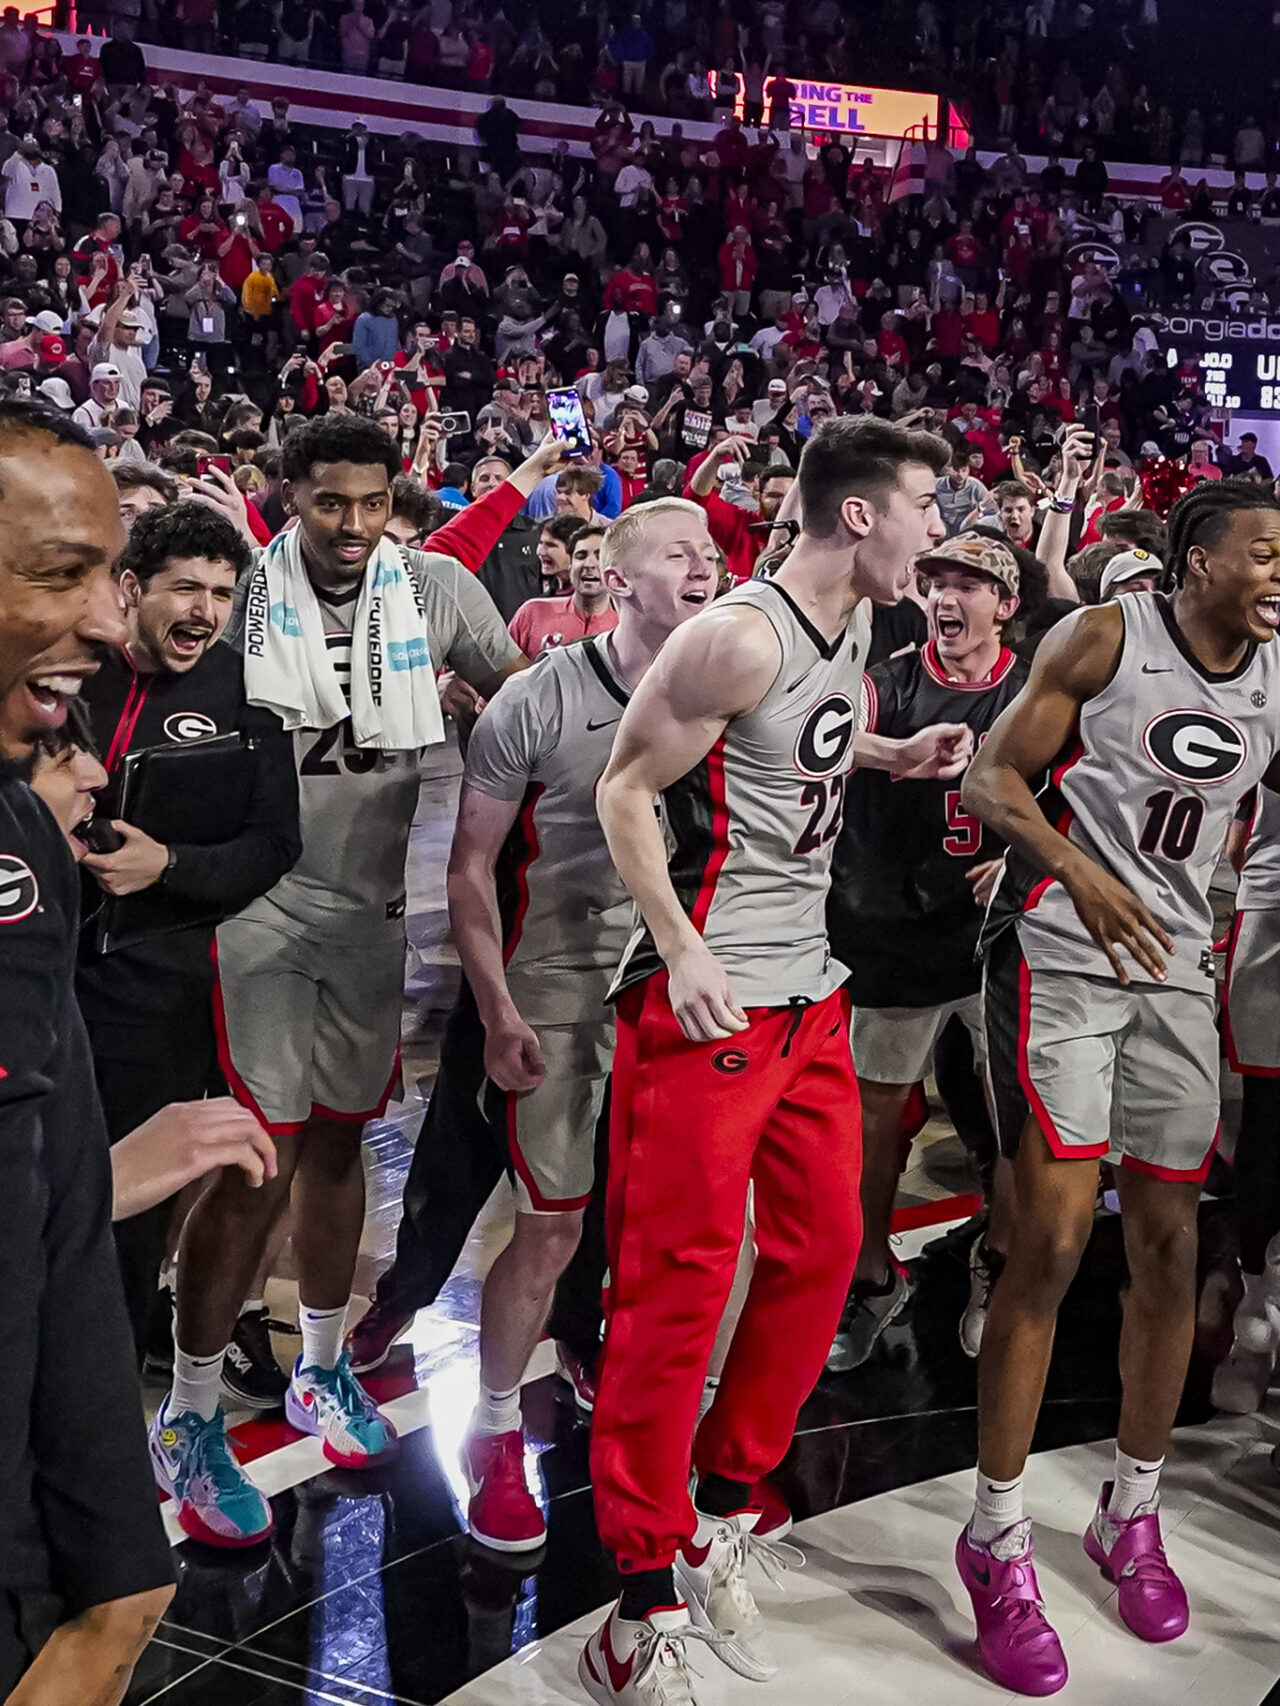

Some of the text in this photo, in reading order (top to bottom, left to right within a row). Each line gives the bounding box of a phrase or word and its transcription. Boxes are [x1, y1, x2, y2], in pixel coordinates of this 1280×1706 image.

[845, 91, 873, 104] THE
[1144, 709, 1246, 784] G
[943, 790, 983, 856] 5
[1138, 787, 1206, 862] 10
[227, 1341, 253, 1375] OKA
